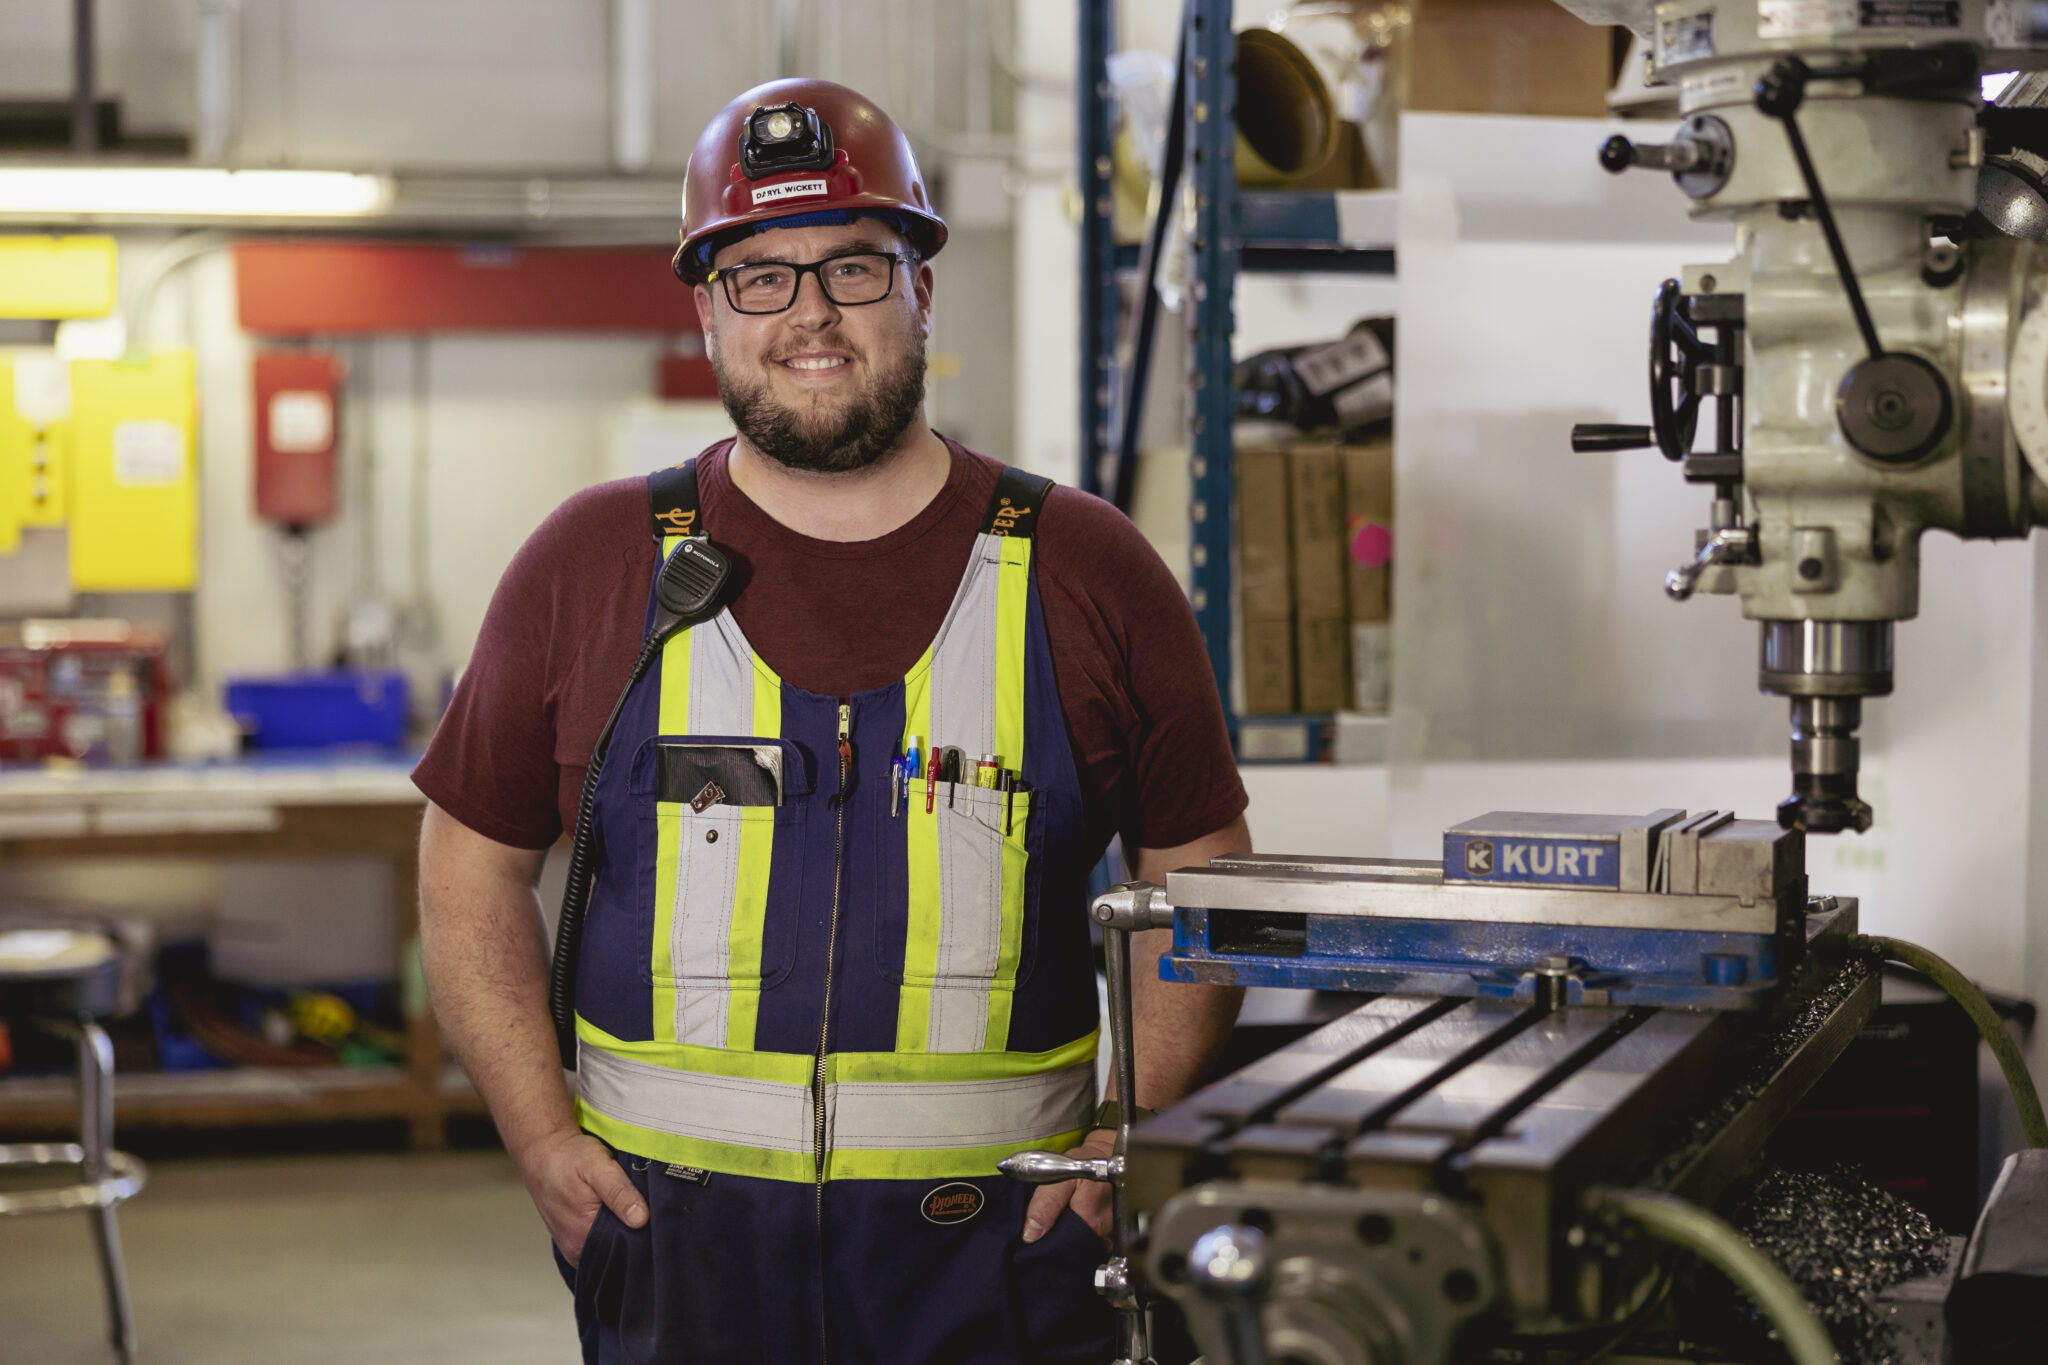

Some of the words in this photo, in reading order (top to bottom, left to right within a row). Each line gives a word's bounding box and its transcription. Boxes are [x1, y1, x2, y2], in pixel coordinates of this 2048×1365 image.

[785, 184, 822, 193] WICKETT
[655, 508, 695, 537] PI
[693, 550, 719, 568] MOTOROLA
[1468, 850, 1490, 869] K
[1503, 845, 1603, 876] KURT
[930, 1193, 977, 1216] PIONEER
